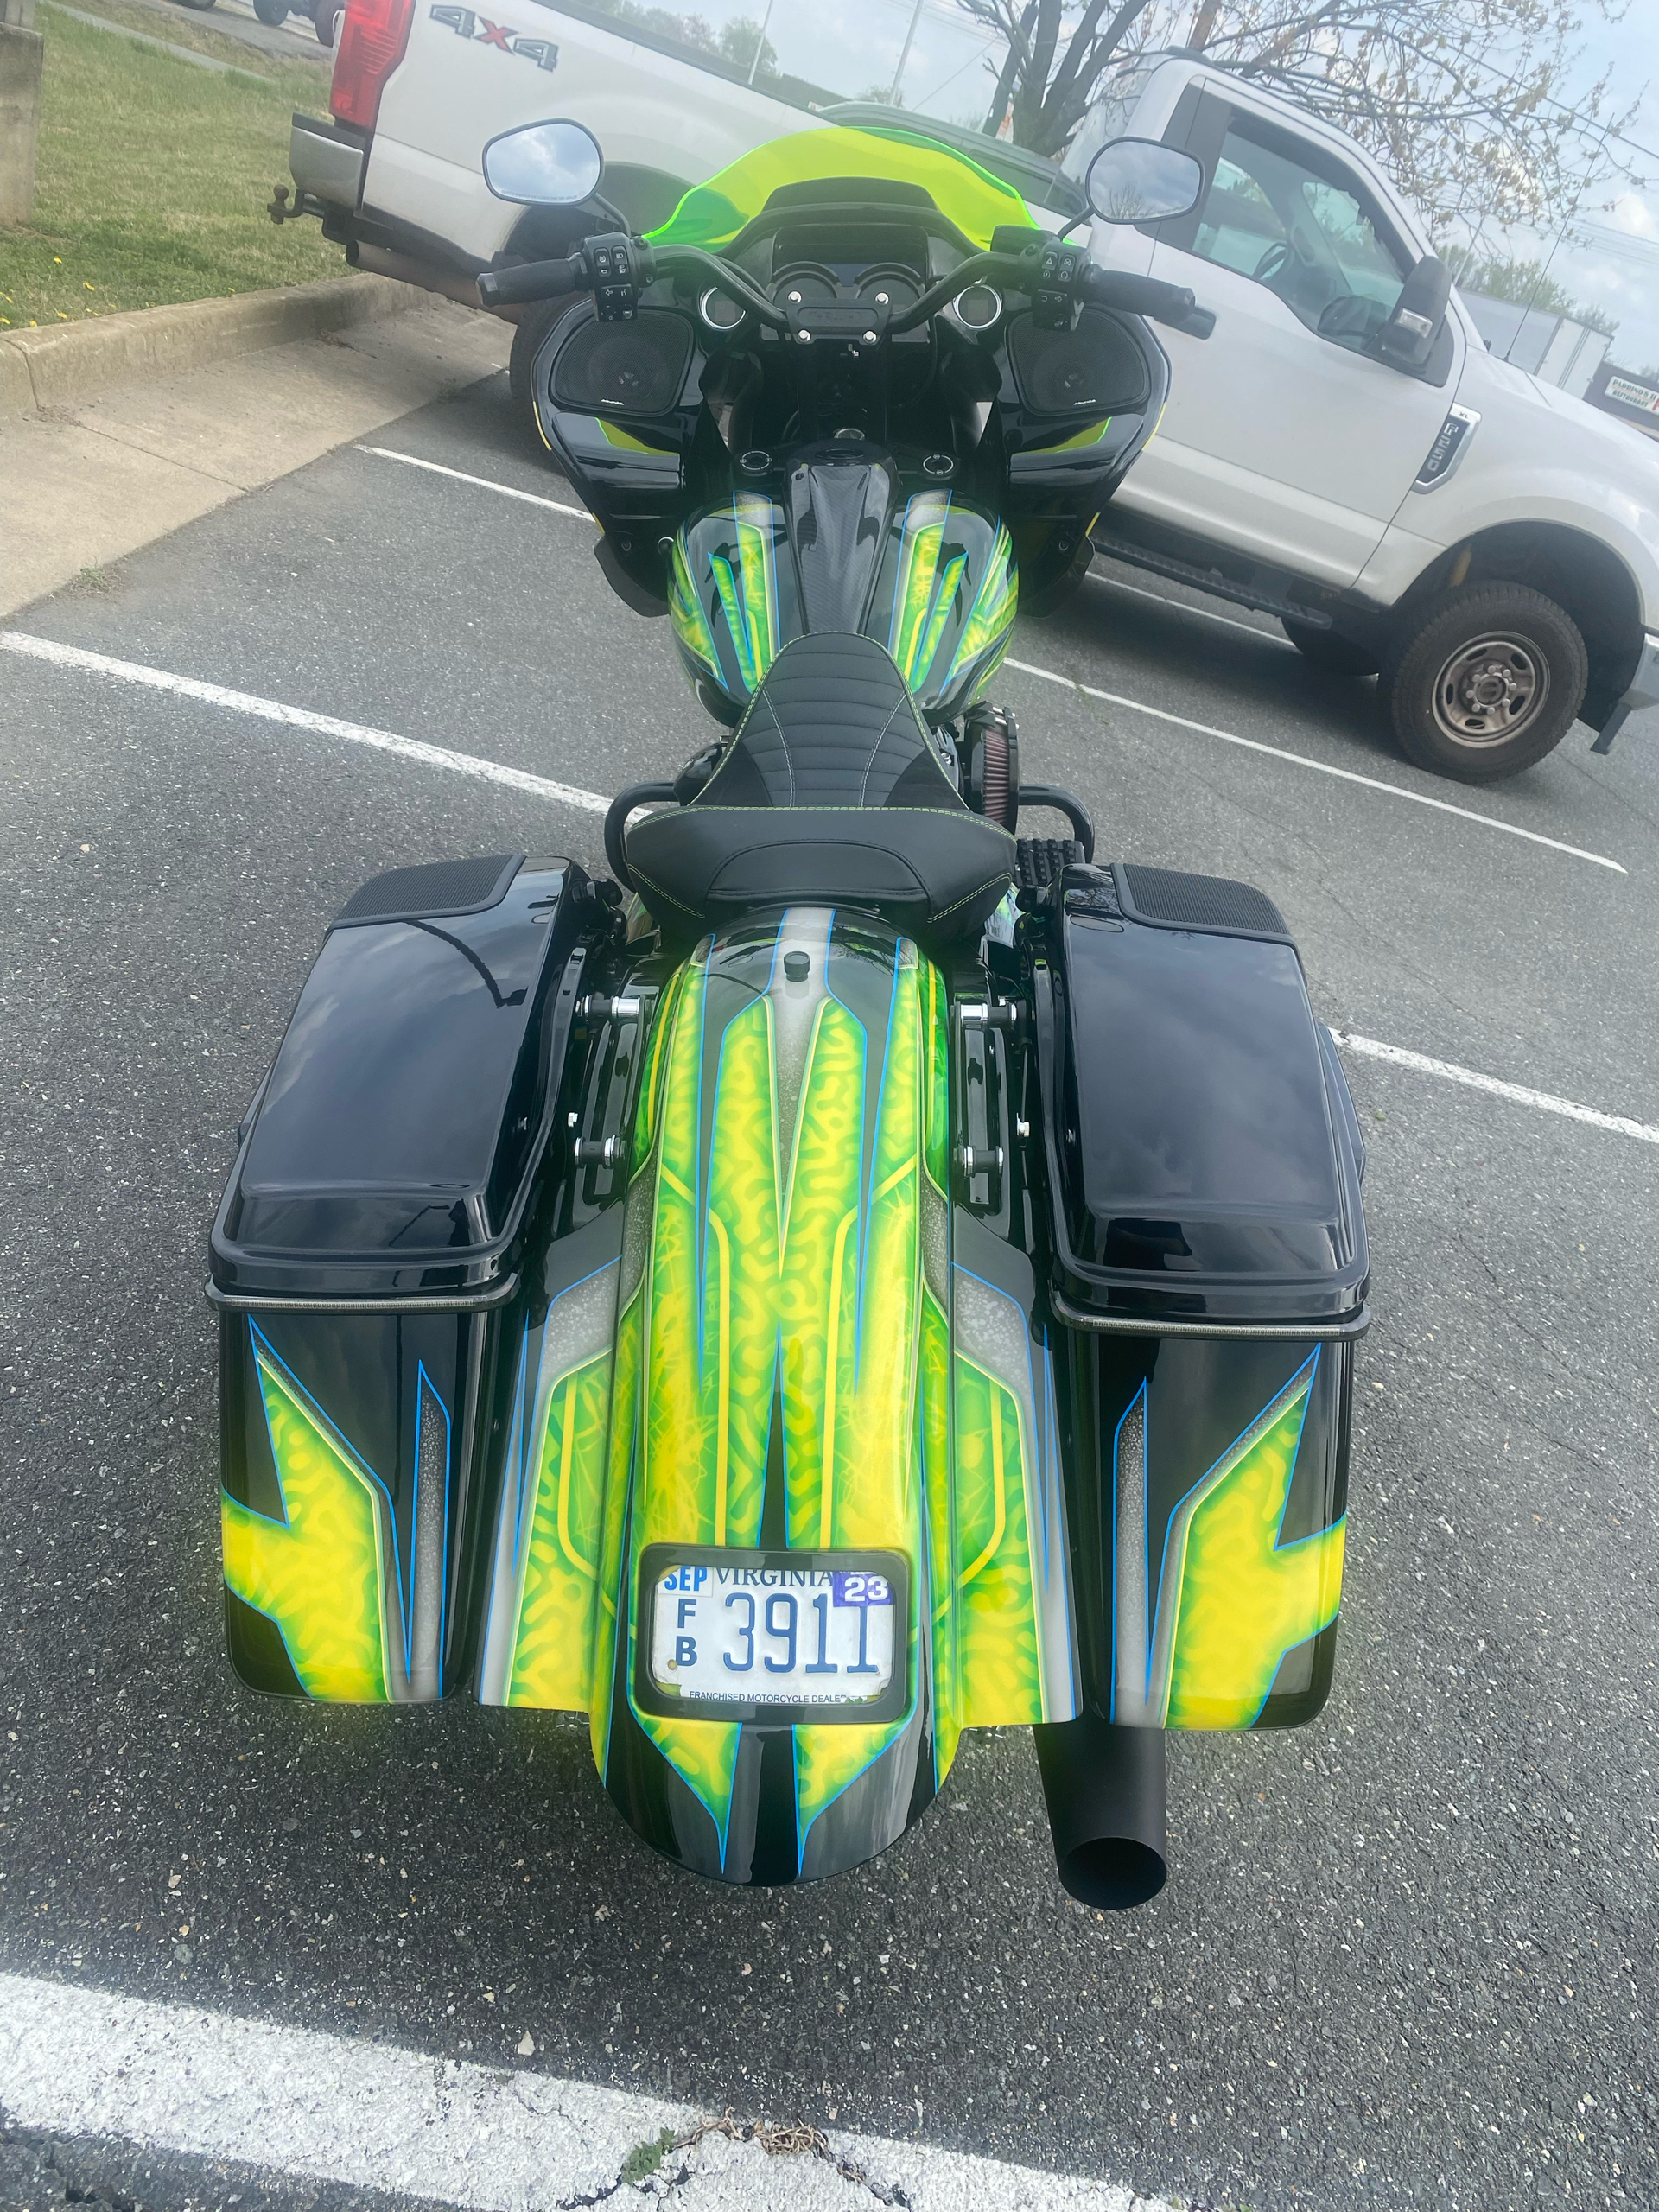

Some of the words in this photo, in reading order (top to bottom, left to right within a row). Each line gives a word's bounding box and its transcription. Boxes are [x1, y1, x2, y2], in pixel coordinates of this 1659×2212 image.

[664, 1566, 708, 1592] SEP
[715, 1567, 833, 1587] VIRGINIA
[844, 1575, 889, 1602] 23
[722, 1592, 879, 1674] 3911
[690, 1690, 746, 1702] FRANCHISED
[747, 1694, 810, 1704] MOTORCYCLE
